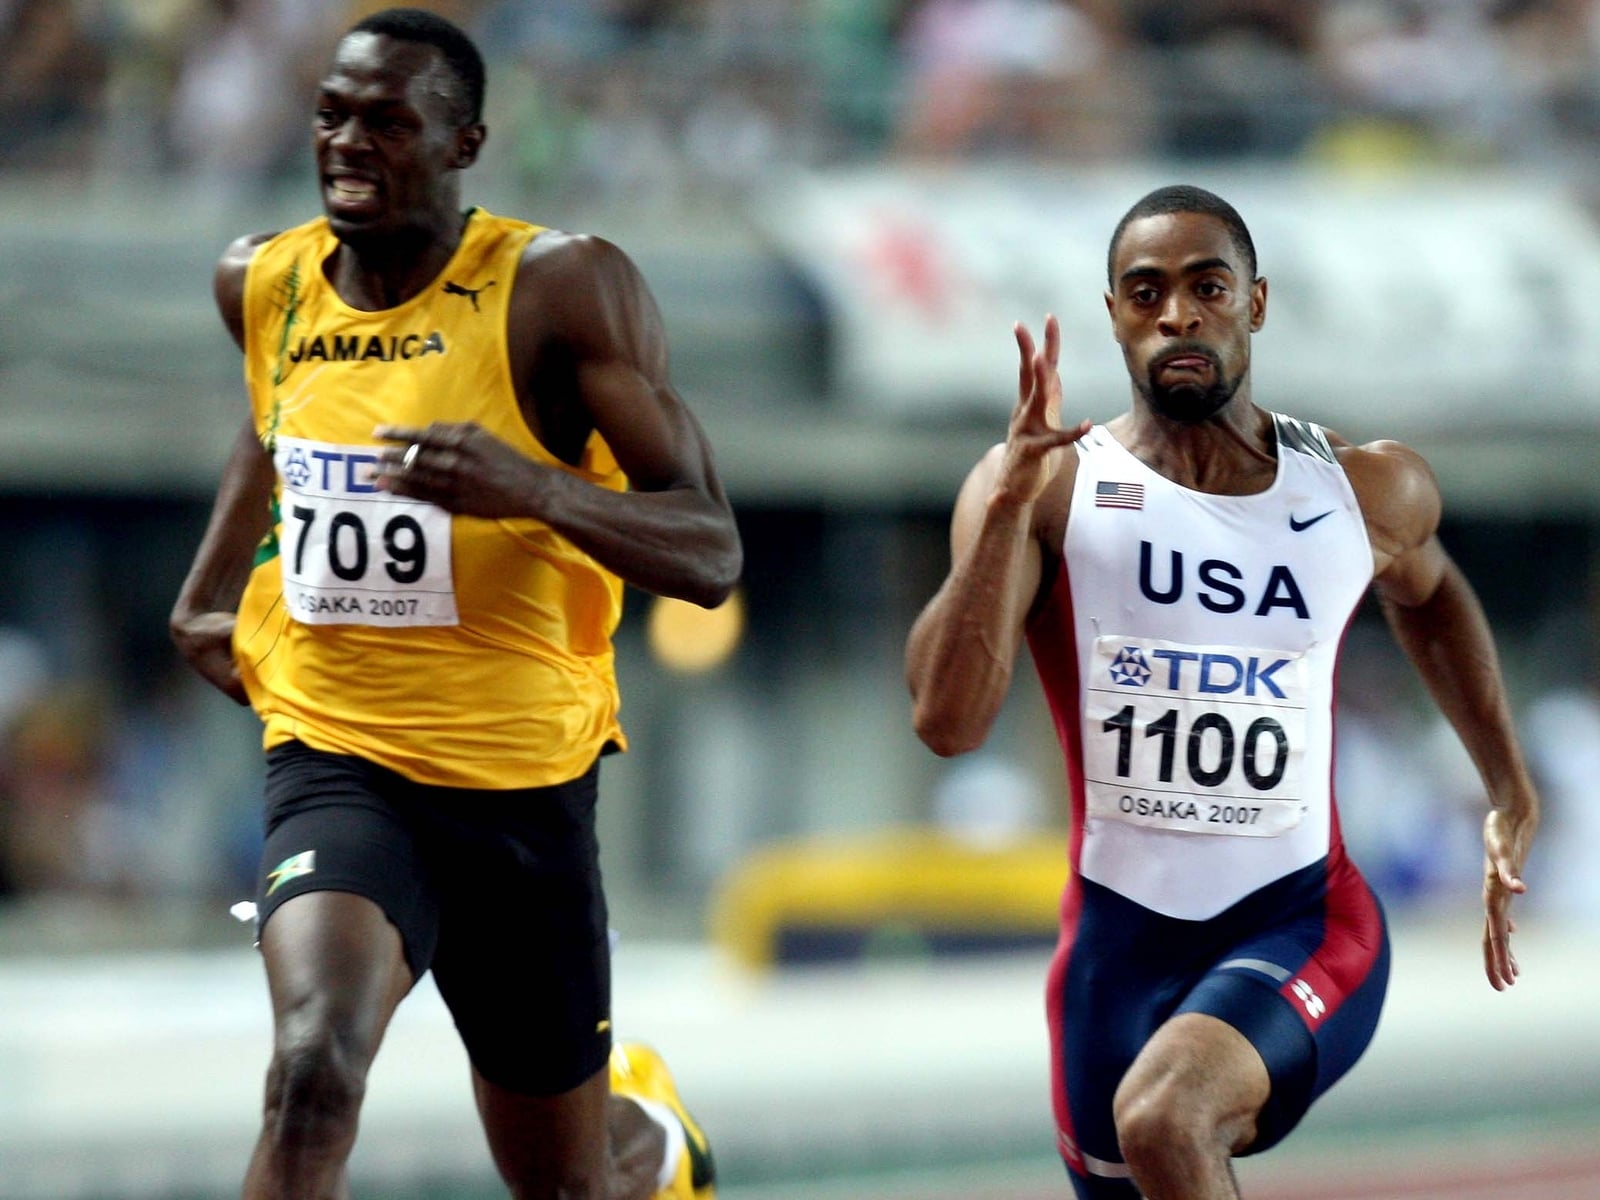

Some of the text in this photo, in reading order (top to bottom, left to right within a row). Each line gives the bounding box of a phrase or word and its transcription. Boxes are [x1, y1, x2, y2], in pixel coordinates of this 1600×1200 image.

[289, 331, 446, 363] JAMAICA
[312, 450, 384, 494] TD
[293, 504, 427, 584] 709
[1139, 540, 1311, 620] USA
[369, 598, 419, 616] 2007
[1152, 648, 1292, 699] TDK
[1103, 704, 1289, 791] 1100
[1119, 795, 1264, 825] OSAKA 2007
